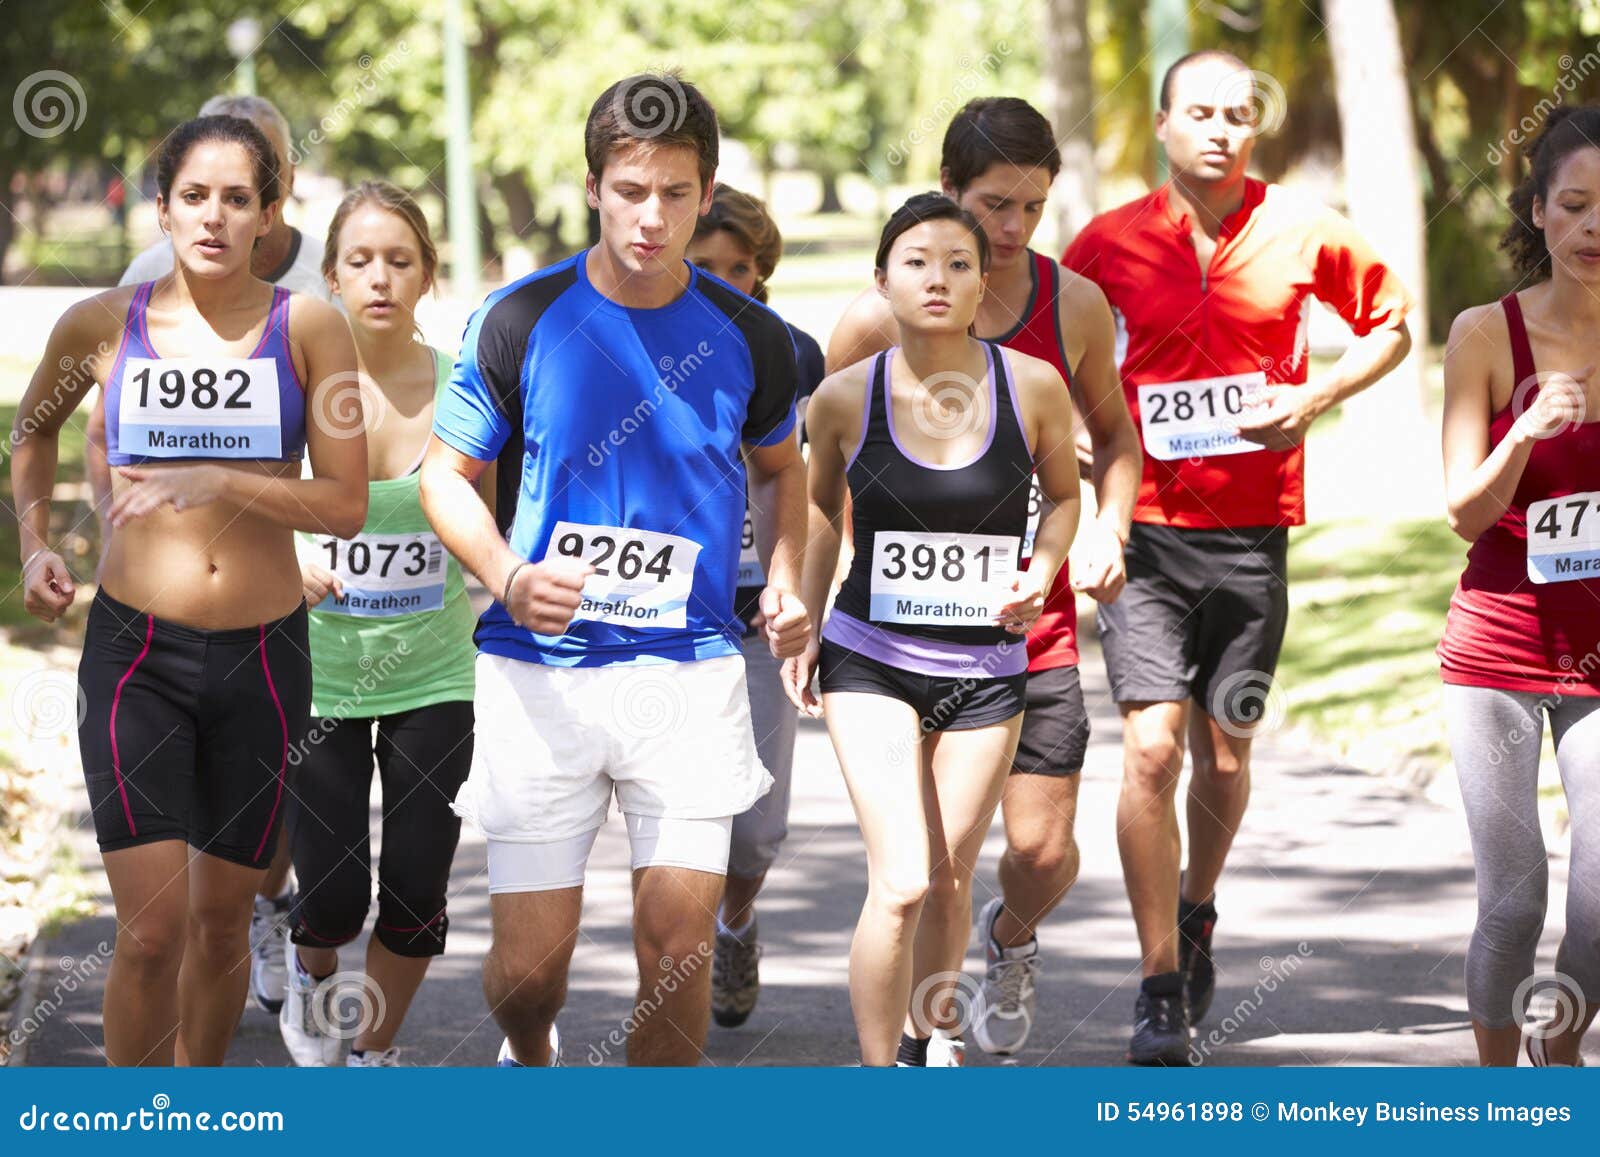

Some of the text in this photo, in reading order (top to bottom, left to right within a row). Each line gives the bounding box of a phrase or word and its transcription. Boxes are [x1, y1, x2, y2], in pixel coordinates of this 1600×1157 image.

[132, 368, 252, 409] 1982
[1147, 384, 1243, 424] 2810
[148, 430, 251, 449] Marathon
[1169, 433, 1243, 452] Maratho
[1534, 500, 1600, 539] 47
[323, 539, 426, 578] 1073
[557, 532, 674, 583] 9264
[882, 542, 991, 582] 3981
[334, 594, 421, 610] Marathon
[581, 599, 659, 620] arathon
[896, 600, 988, 618] Marathon
